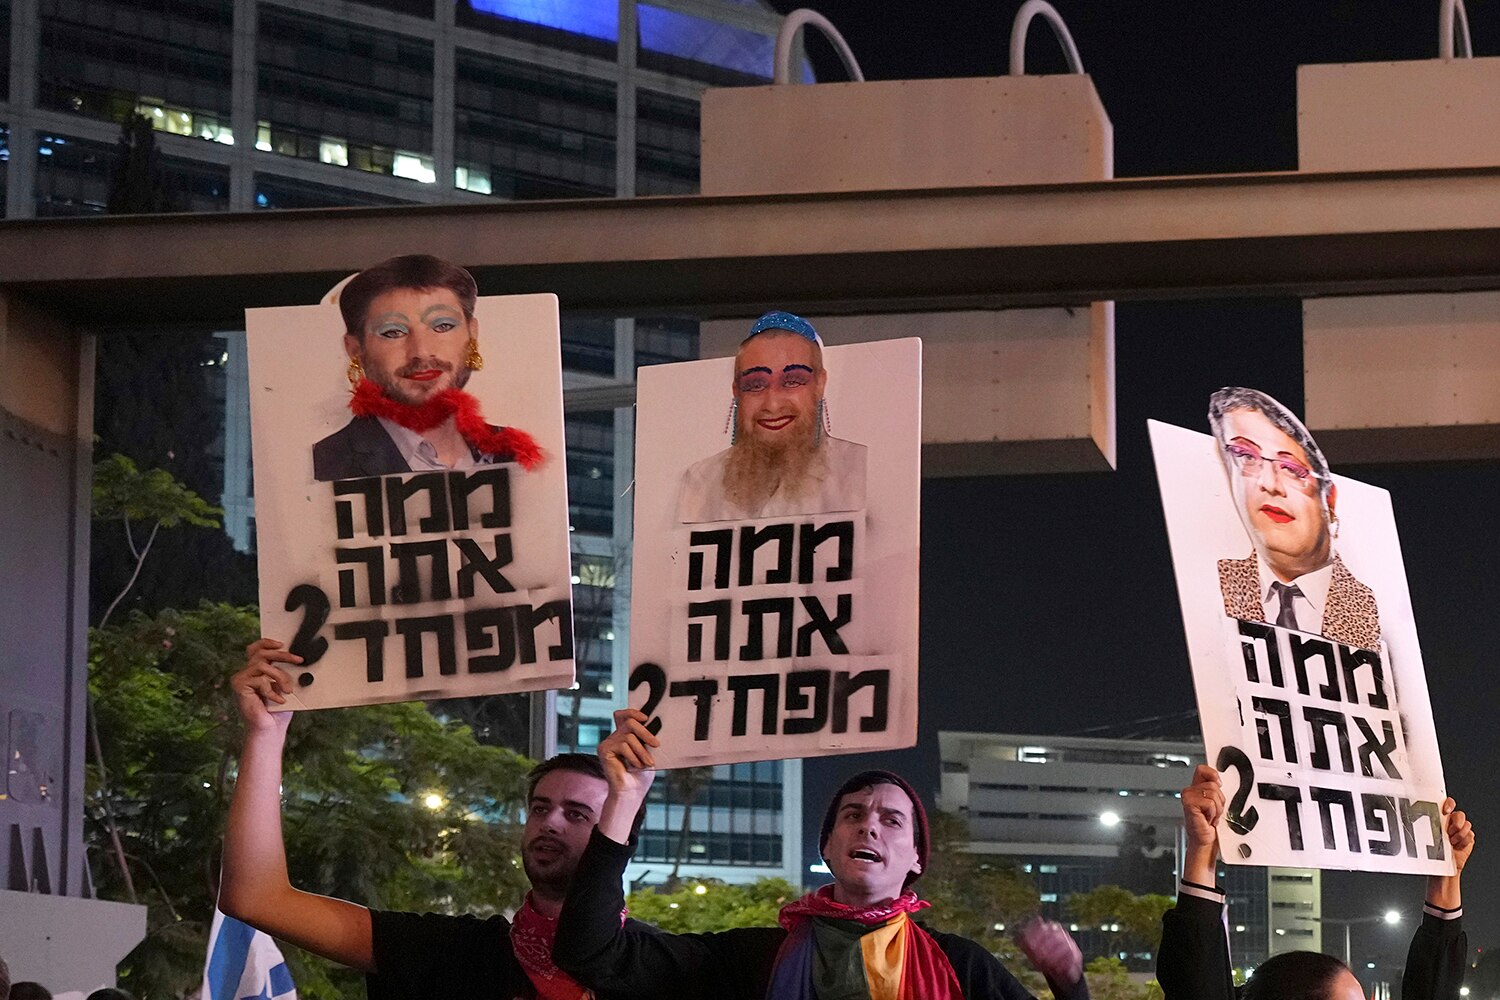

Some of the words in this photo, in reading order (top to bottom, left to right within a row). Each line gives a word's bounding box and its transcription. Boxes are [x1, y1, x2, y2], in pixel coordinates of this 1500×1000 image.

[333, 468, 512, 539] ממה
[334, 533, 516, 608] אתה
[687, 521, 854, 590] ממה
[284, 599, 575, 688] מפחד?
[687, 593, 850, 662] אתה
[1237, 620, 1389, 710] ממה
[1251, 695, 1403, 781] אתה
[1216, 745, 1446, 861] מפחד?
